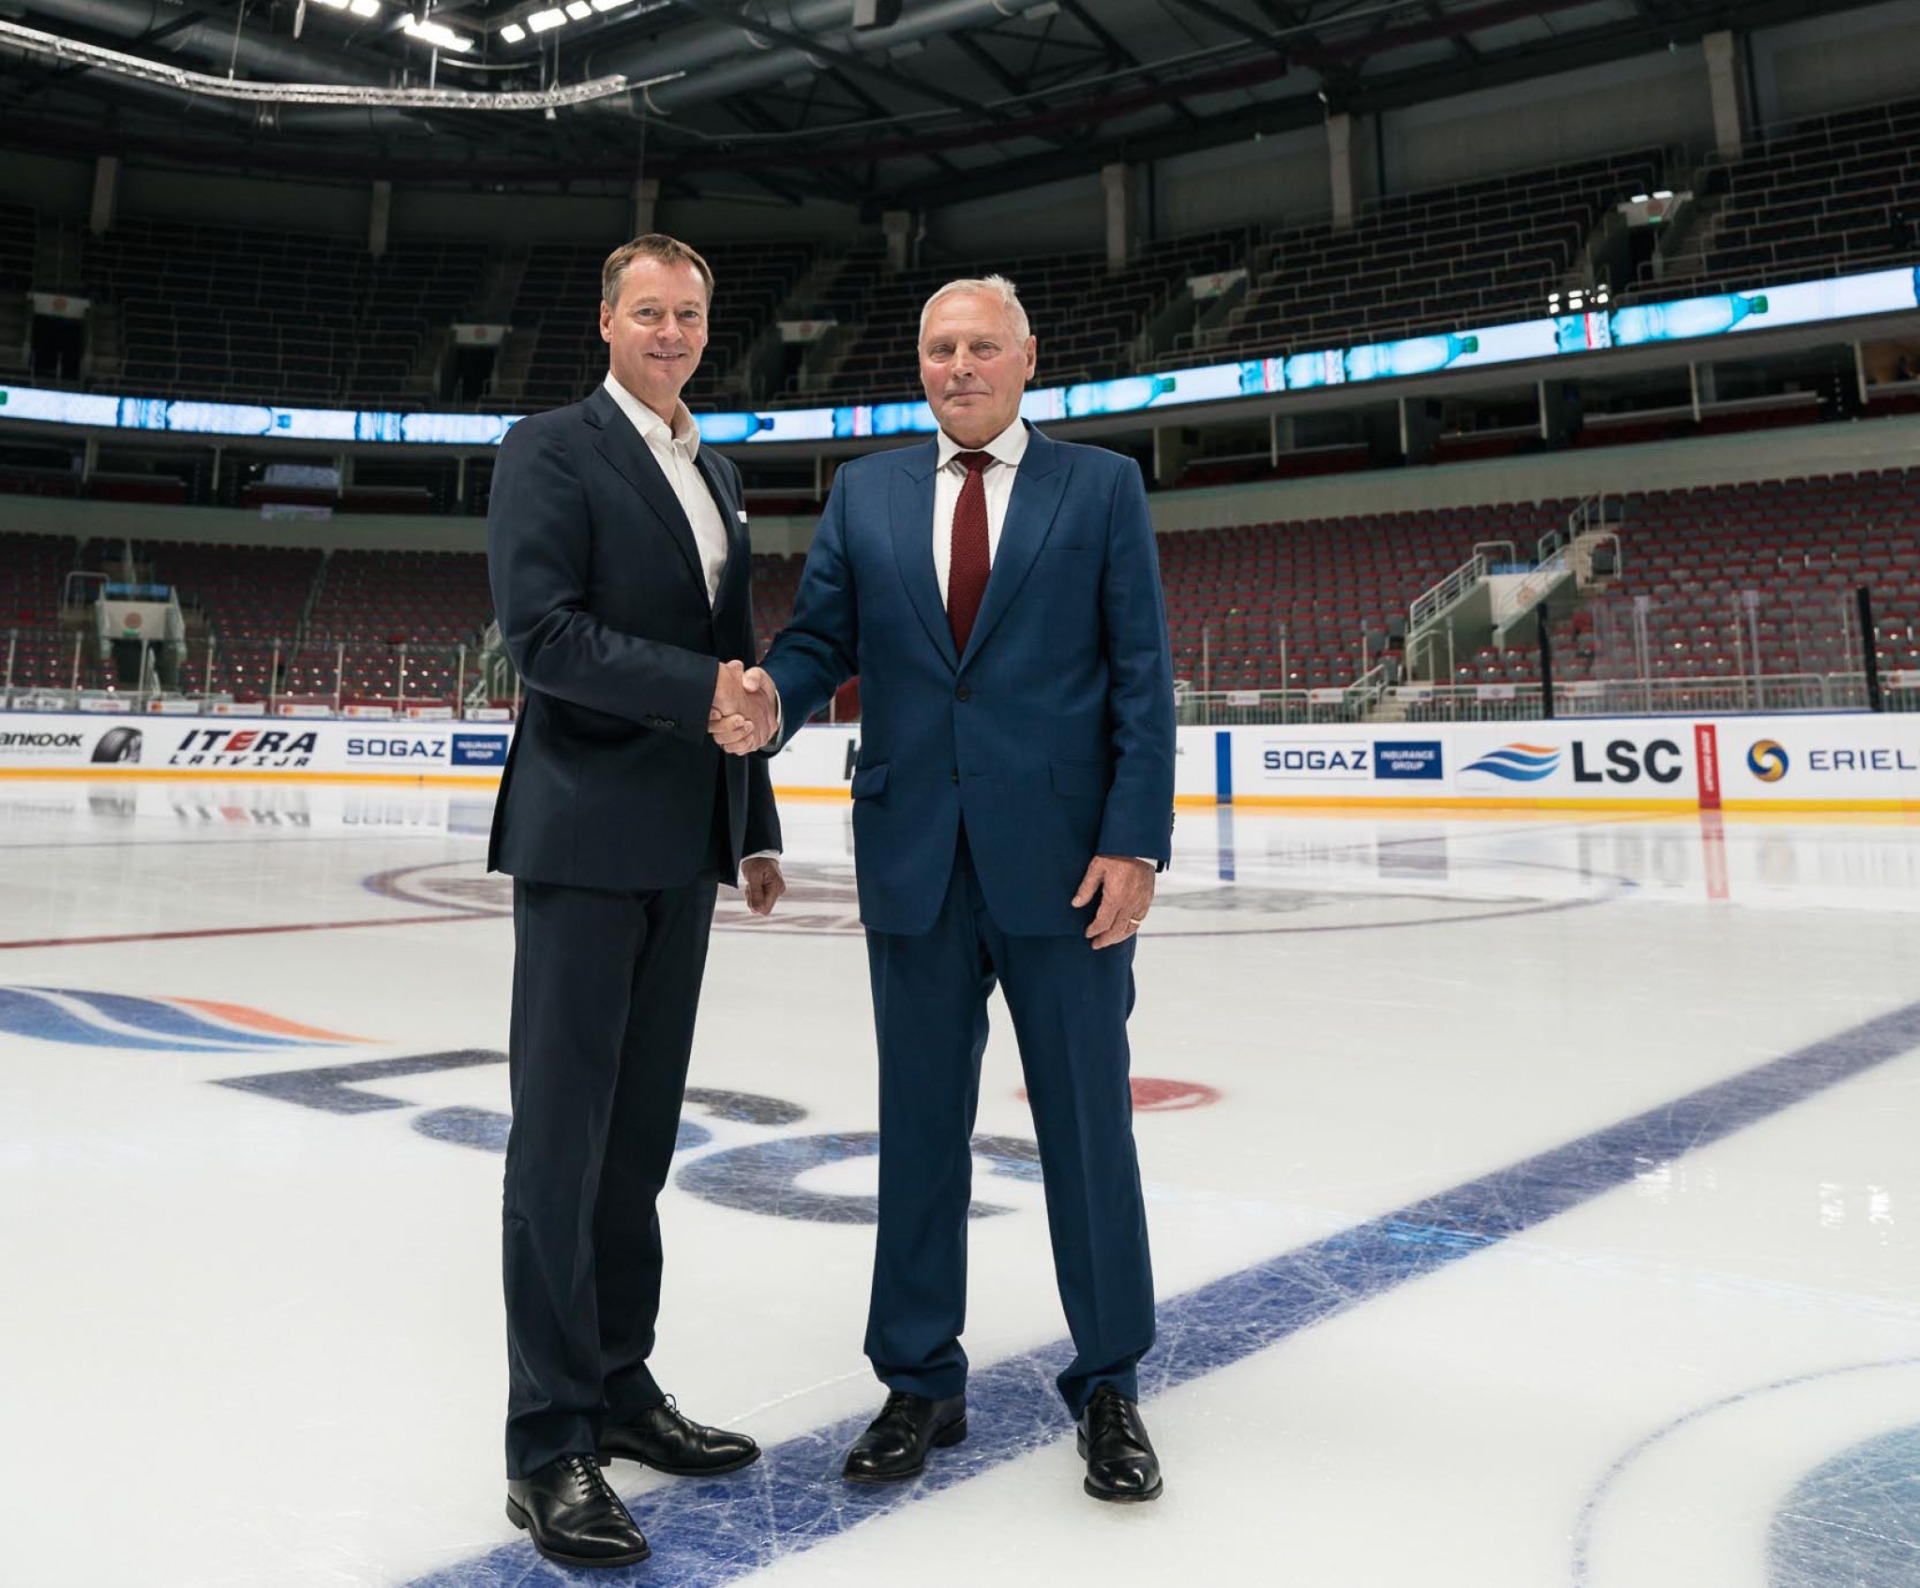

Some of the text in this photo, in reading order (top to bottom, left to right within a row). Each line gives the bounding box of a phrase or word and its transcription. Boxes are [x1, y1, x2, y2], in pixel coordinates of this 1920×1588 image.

[178, 730, 317, 752] ITERA
[347, 739, 445, 757] SOGAZ
[1264, 751, 1368, 770] SOGAZ
[1571, 739, 1682, 783] LSC
